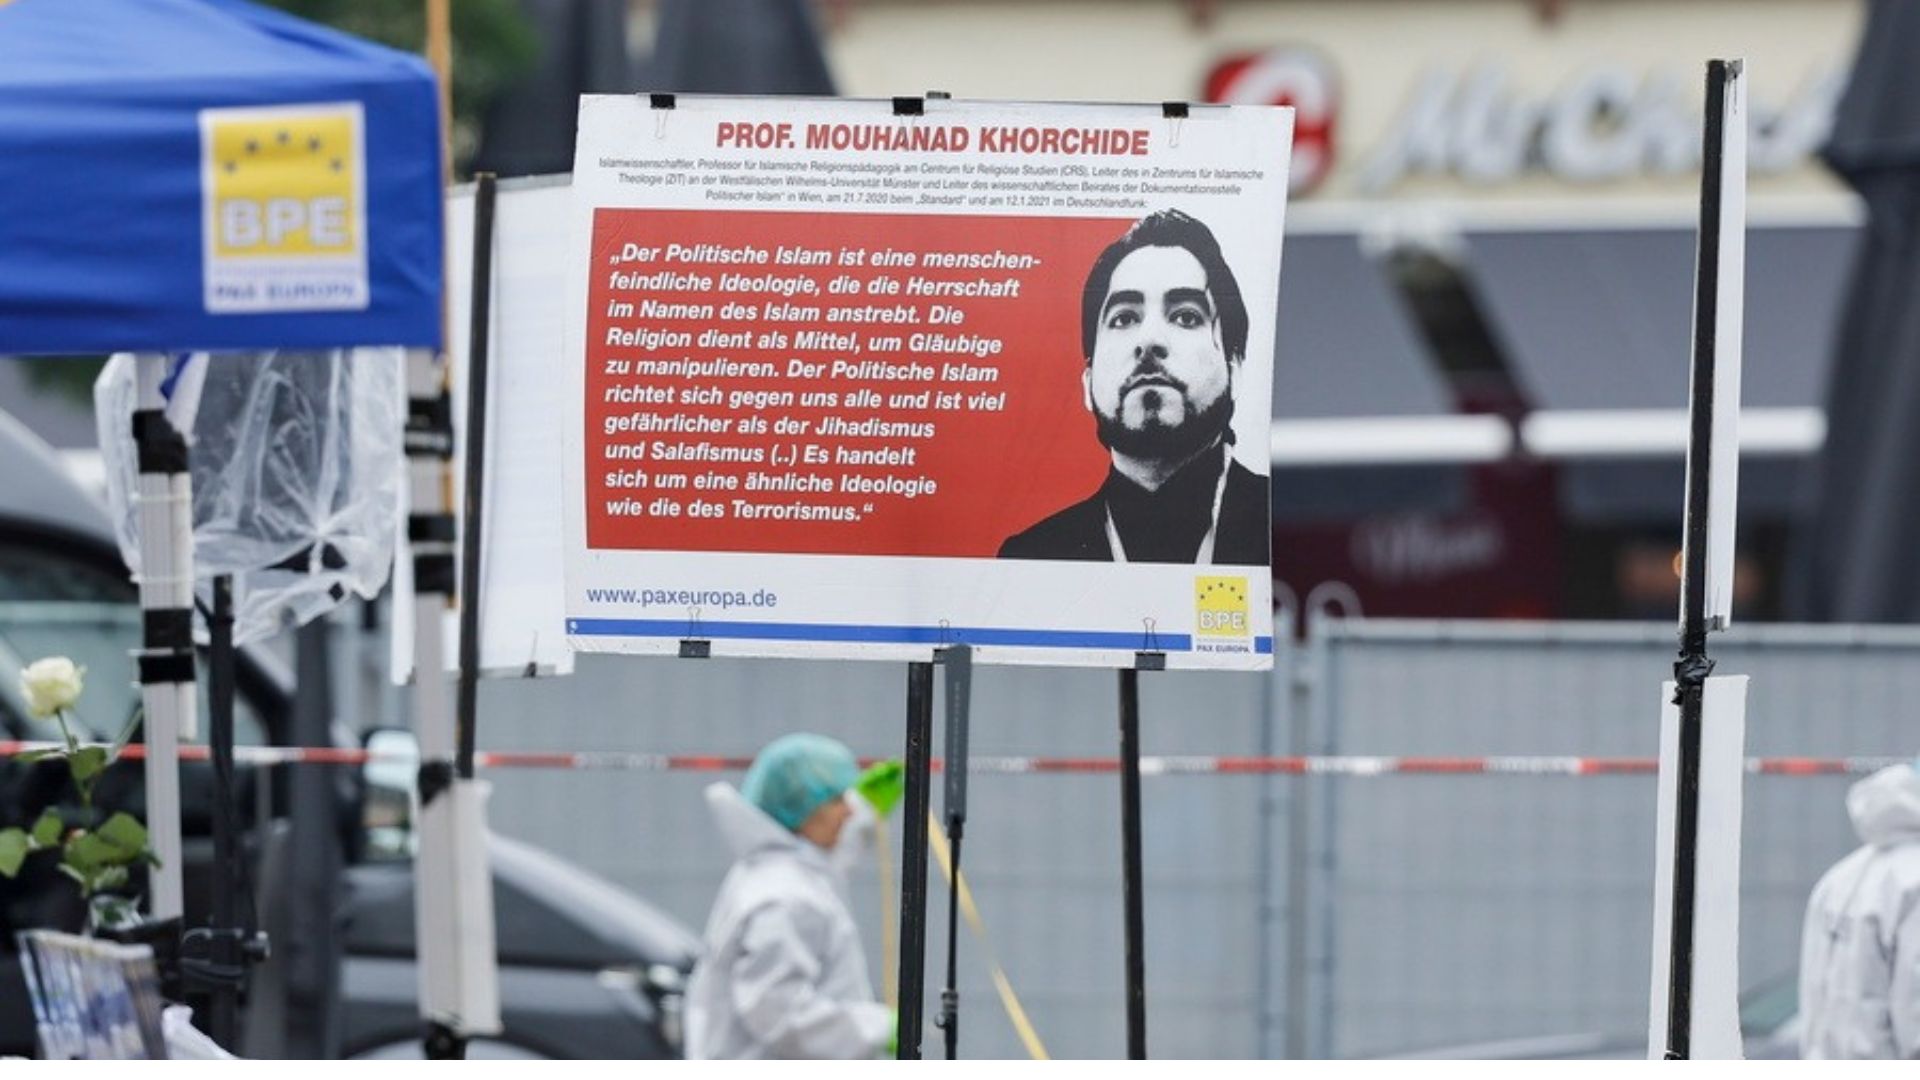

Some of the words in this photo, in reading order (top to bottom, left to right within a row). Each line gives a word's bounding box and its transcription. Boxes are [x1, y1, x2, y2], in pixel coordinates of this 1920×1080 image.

[716, 122, 795, 149] PROF.
[805, 124, 969, 152] MOUHANAD
[979, 127, 1150, 155] KHORCHIDE
[698, 159, 742, 170] Professor
[744, 160, 757, 170] für
[759, 160, 808, 171] Islamische
[811, 161, 901, 175] Religionspädagogik
[904, 165, 918, 173] am
[921, 163, 960, 174] Centrum
[963, 164, 975, 174] für
[977, 164, 1020, 177] Religiöse
[1022, 164, 1058, 176] Studien
[1092, 167, 1120, 177] Leiter
[1122, 168, 1139, 178] des
[1141, 169, 1150, 177] in
[1152, 167, 1197, 178] Zentrums
[1199, 169, 1212, 178] für
[1214, 169, 1263, 179] Islamische
[619, 173, 663, 186] Theologie
[688, 176, 700, 185] an
[702, 175, 717, 185] der
[720, 175, 783, 186] Westfälischen
[785, 176, 881, 188] Wilhelms-Universität
[883, 178, 921, 189] Münster
[923, 179, 941, 189] und
[943, 180, 969, 189] Leiter
[971, 180, 988, 190] des
[991, 181, 1079, 191] wissenschaftlichen
[1081, 181, 1120, 192] Beirates
[1122, 183, 1138, 193] der
[1141, 182, 1241, 195] Dokumentationsstelle
[706, 190, 754, 201] Politischer
[788, 193, 796, 201] in
[799, 192, 823, 203] Wien,
[890, 194, 913, 204] beim
[969, 196, 987, 206] und
[988, 197, 1003, 205] am
[1053, 198, 1065, 206] im
[222, 197, 349, 247] BPE
[664, 243, 769, 265] Politische
[774, 245, 833, 265] Islam
[837, 247, 866, 266] ist
[870, 247, 917, 267] eine
[922, 250, 1041, 269] menschen-
[609, 271, 713, 292] feindliche
[718, 273, 821, 297] Ideologie,
[828, 275, 861, 294] die
[867, 275, 900, 295] die
[906, 276, 1021, 298] Herrschaft
[607, 299, 634, 318] im
[639, 299, 714, 320] Namen
[719, 301, 758, 321] des
[763, 301, 821, 322] Islam
[826, 304, 921, 324] anstrebt.
[928, 305, 964, 325] Die
[605, 327, 692, 351] Religion
[697, 329, 753, 349] dient
[757, 330, 788, 350] als
[793, 330, 861, 355] Mittel,
[868, 336, 902, 352] um
[908, 333, 1003, 358] Gläubige
[605, 360, 631, 375] zu
[636, 358, 780, 379] manipulieren.
[786, 360, 827, 379] Der
[831, 360, 935, 381] Politische
[941, 362, 999, 382] Islam
[604, 385, 675, 404] richtet
[680, 386, 724, 405] sich
[729, 390, 794, 410] gegen
[799, 392, 839, 407] uns
[843, 388, 882, 409] alle
[888, 390, 930, 409] und
[934, 390, 963, 410] ist
[967, 391, 1006, 411] viel
[604, 412, 733, 435] gefährlicher
[737, 415, 768, 435] als
[773, 416, 811, 435] der
[814, 416, 935, 438] Jihadismus
[605, 441, 646, 460] und
[650, 441, 765, 463] Salafismus
[803, 444, 829, 464] Es
[835, 445, 916, 466] handelt
[605, 469, 648, 488] sich
[654, 474, 688, 489] um
[693, 470, 739, 490] eine
[744, 471, 834, 493] ähnliche
[840, 474, 937, 498] Ideologie
[606, 498, 643, 516] wie
[648, 499, 681, 517] die
[687, 499, 725, 518] des
[587, 588, 777, 609] www.paxeuropa.de
[1199, 611, 1244, 630] BPE
